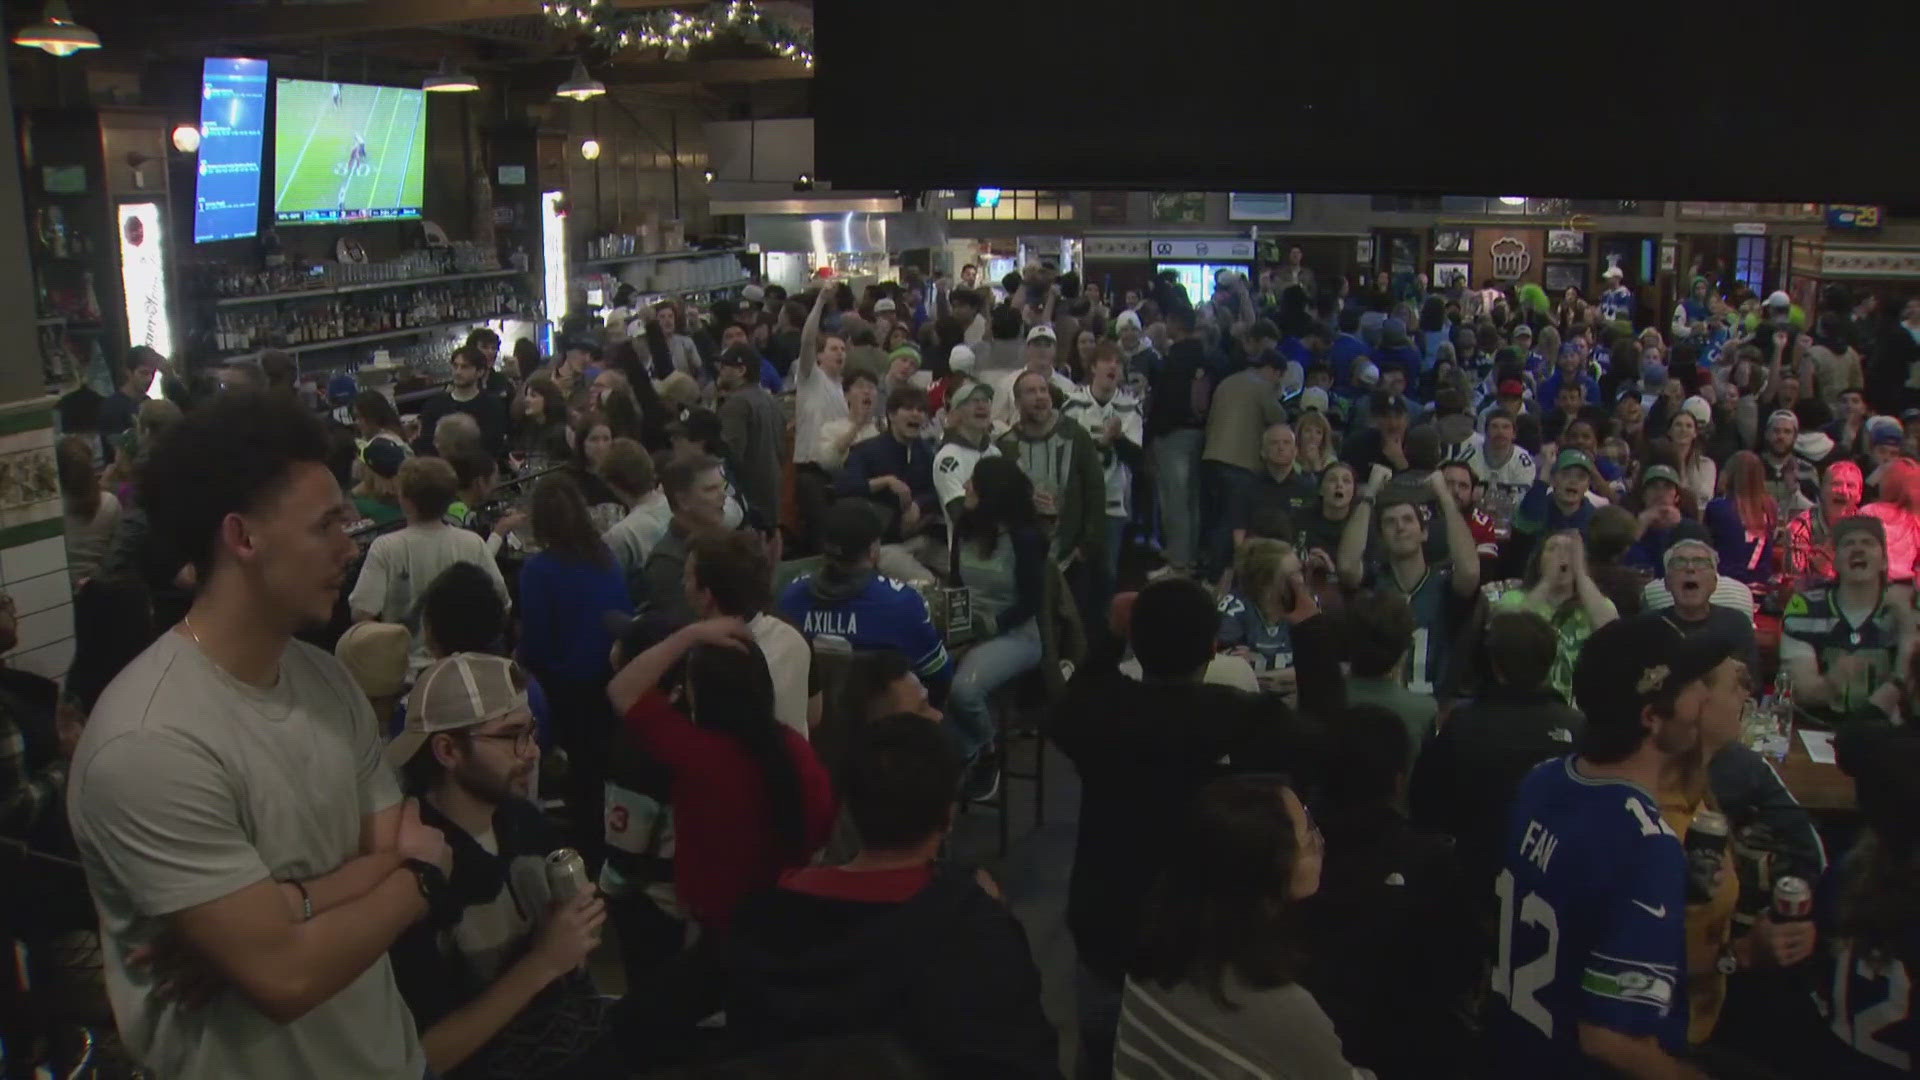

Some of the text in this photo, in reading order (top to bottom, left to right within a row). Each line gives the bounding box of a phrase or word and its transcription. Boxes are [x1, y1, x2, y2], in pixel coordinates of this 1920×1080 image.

[804, 610, 858, 635] AXILLA
[1519, 818, 1559, 875] FAN
[1491, 866, 1560, 1040] 12
[1830, 937, 1912, 1071] 12
